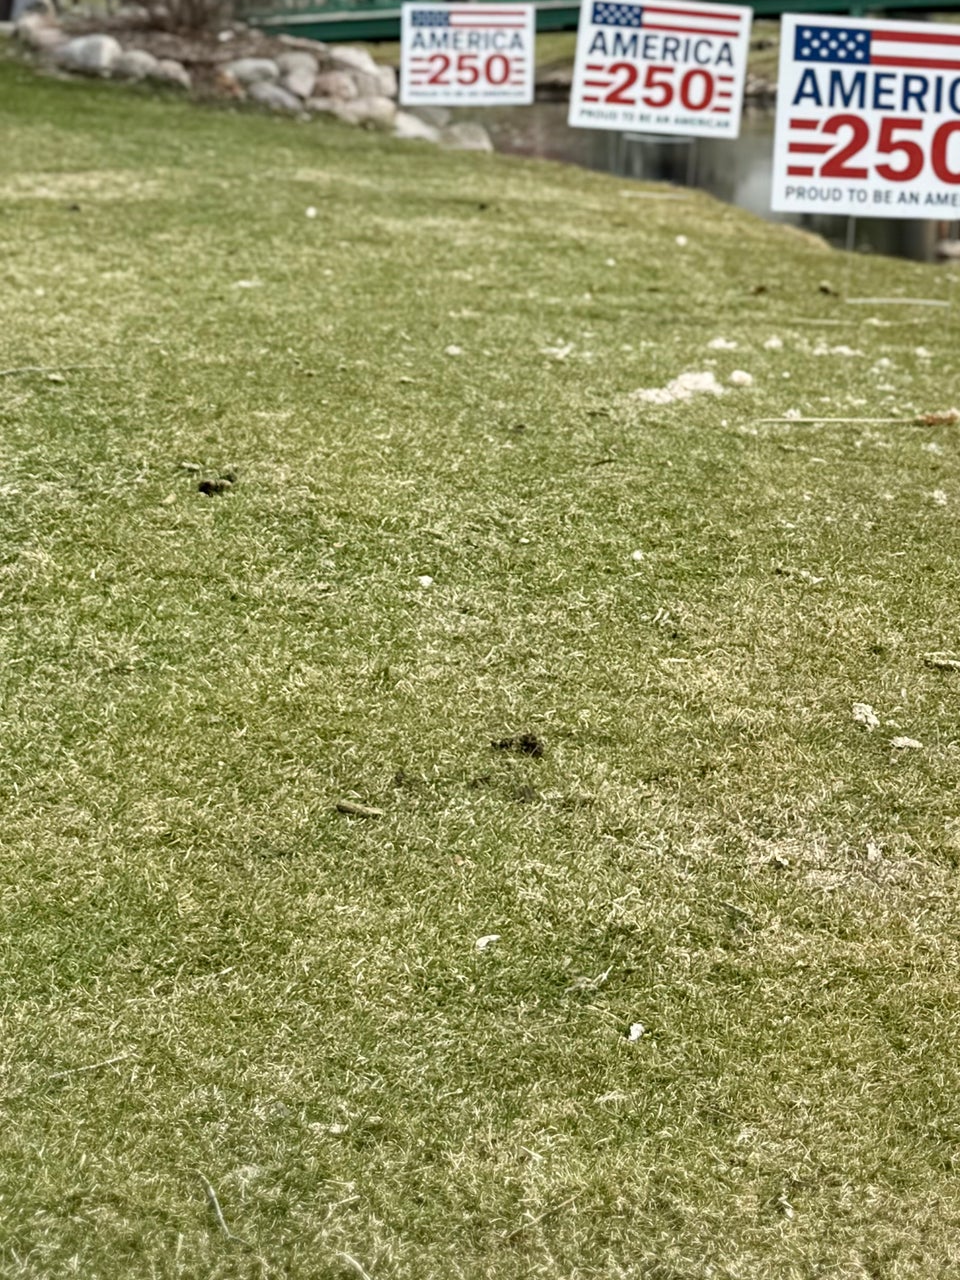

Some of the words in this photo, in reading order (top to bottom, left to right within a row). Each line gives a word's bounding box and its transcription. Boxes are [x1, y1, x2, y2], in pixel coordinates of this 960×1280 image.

[412, 32, 524, 50] AMERICA
[589, 31, 733, 66] AMERICA
[428, 54, 510, 85] 250
[605, 62, 714, 111] 250
[785, 186, 842, 202] PROUD
[847, 189, 867, 203] TO
[873, 190, 892, 204] BE
[898, 191, 919, 206] AN
